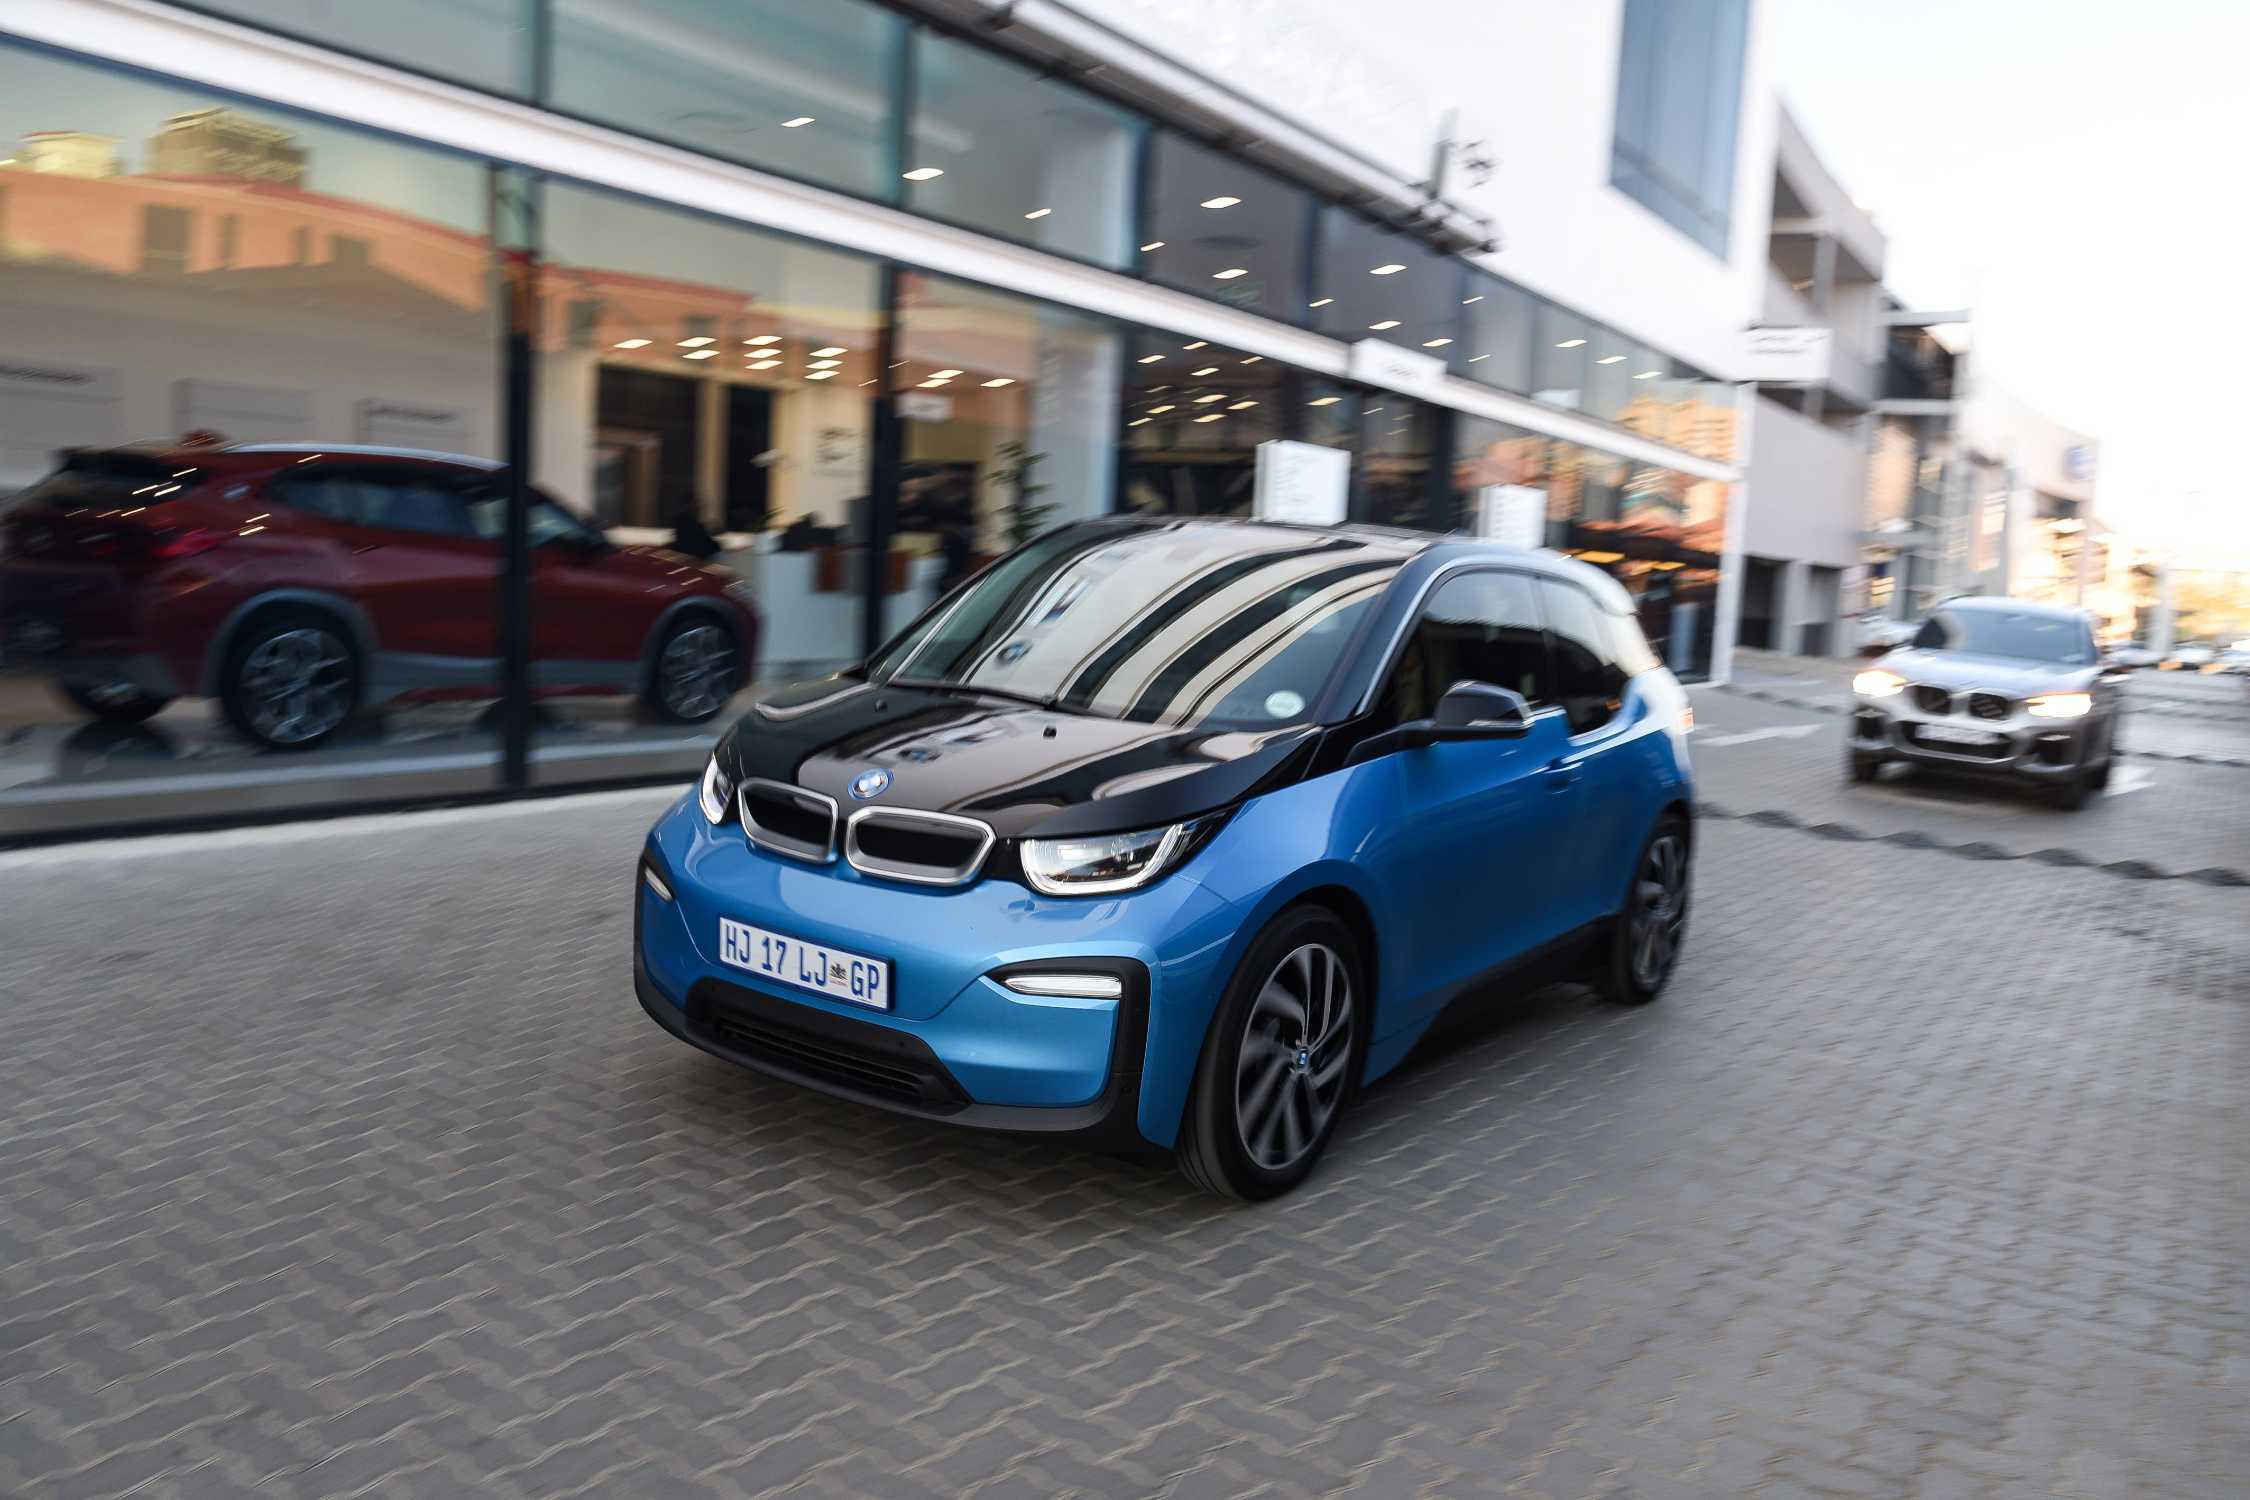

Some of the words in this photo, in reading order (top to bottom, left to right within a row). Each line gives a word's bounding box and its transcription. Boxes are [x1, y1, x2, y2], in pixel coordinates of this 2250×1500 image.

[726, 924, 750, 963] HJ
[761, 937, 786, 974] 17
[799, 946, 827, 986] LJ
[850, 960, 879, 999] GP
